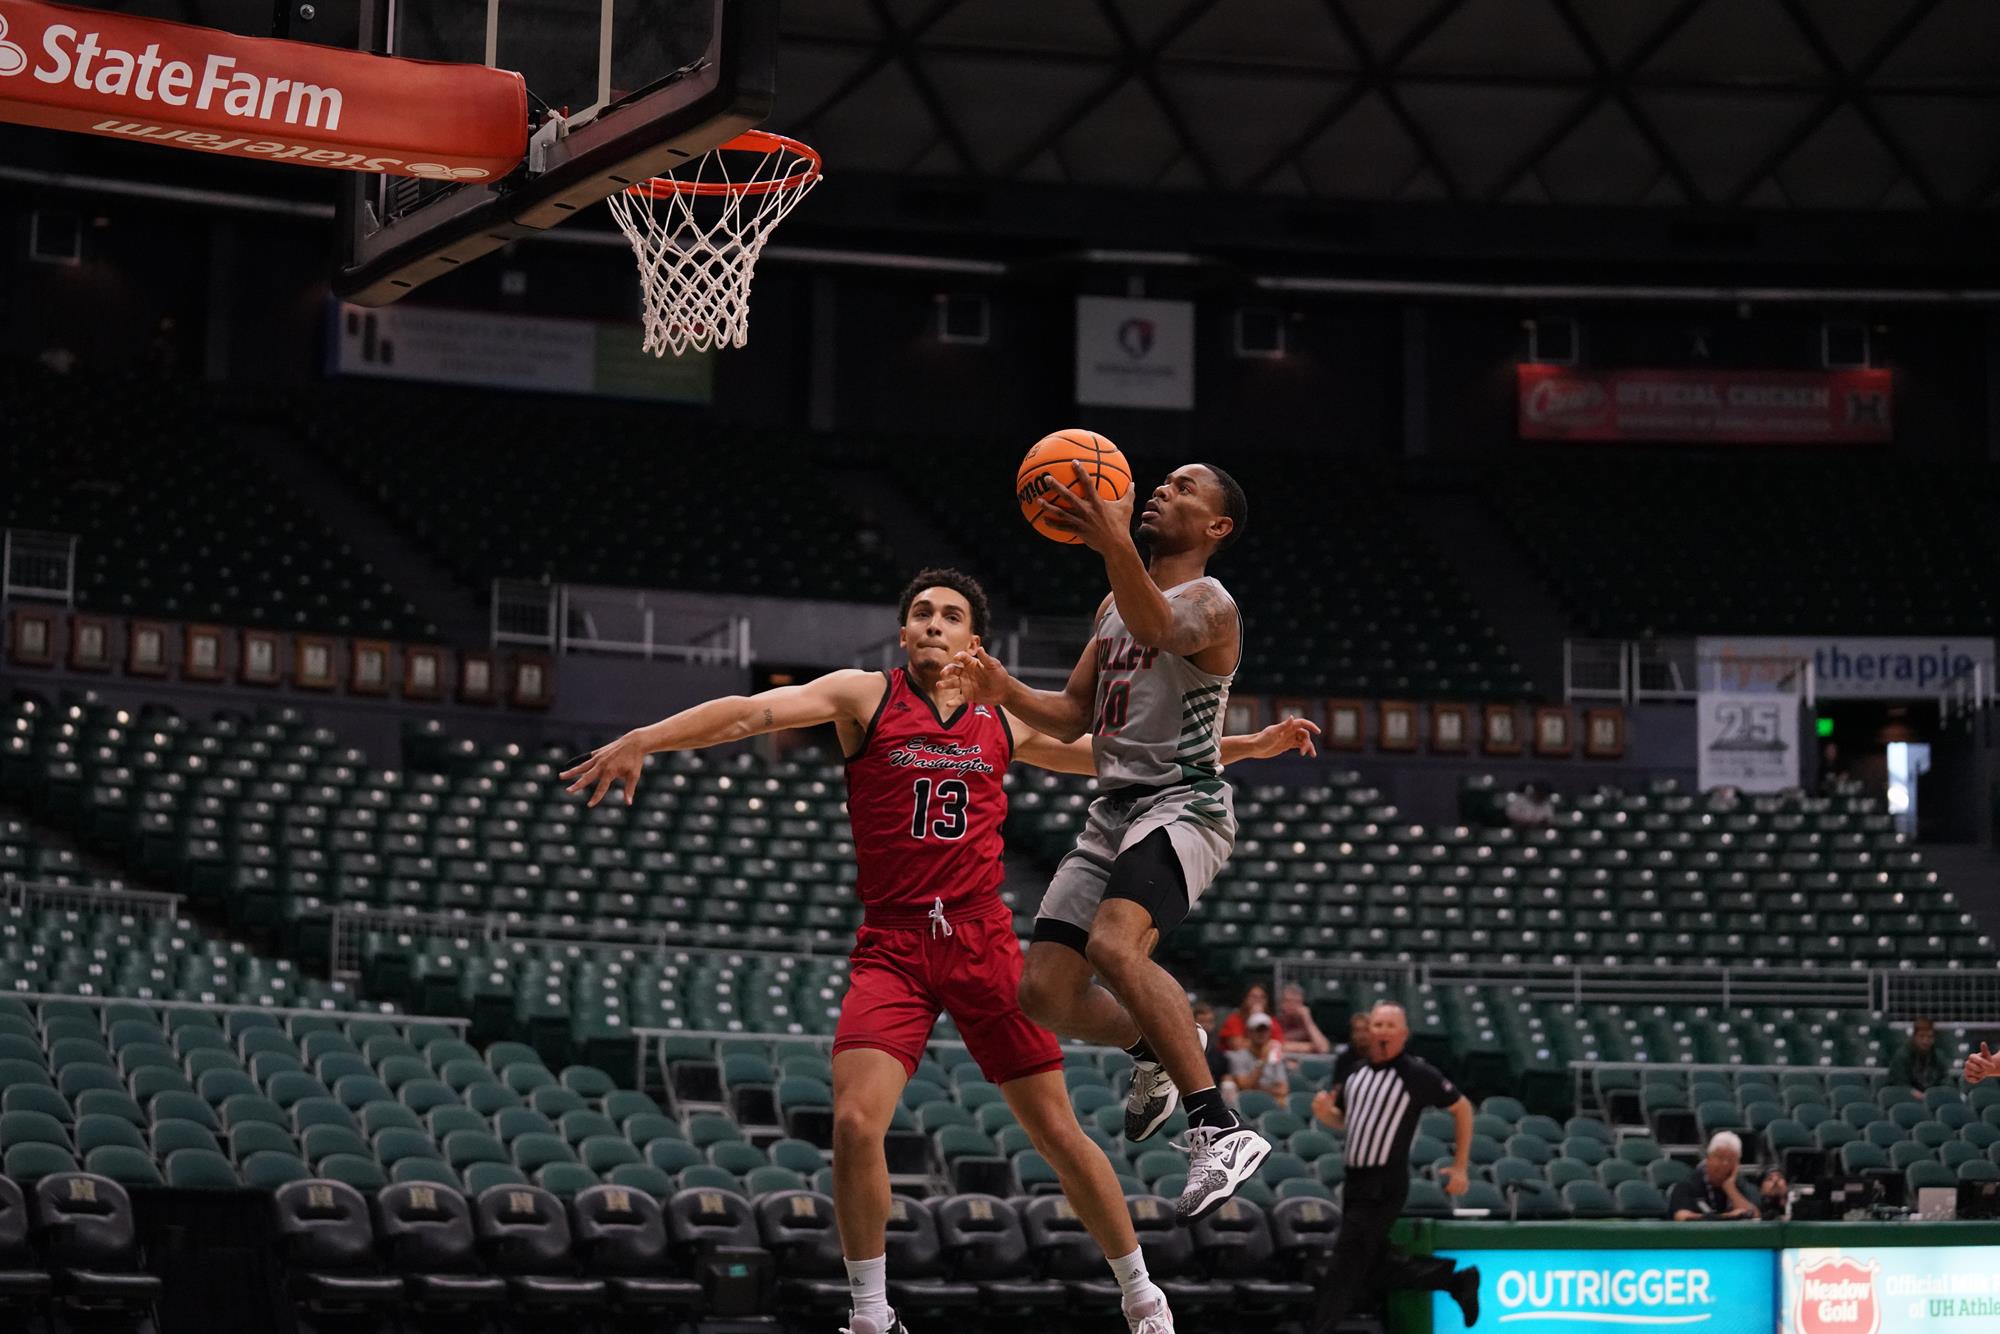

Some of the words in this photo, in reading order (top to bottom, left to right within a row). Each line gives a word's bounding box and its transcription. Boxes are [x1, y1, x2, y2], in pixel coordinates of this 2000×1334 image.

[1814, 644, 1975, 688] therapie
[905, 736, 982, 757] Eastern
[887, 750, 993, 777] Washington
[911, 777, 969, 840] 13
[1496, 1269, 1711, 1308] OUTRIGGER
[1804, 1279, 1871, 1301] Meadow
[1885, 1272, 1949, 1296] Official
[1818, 1300, 1858, 1323] Gold
[1907, 1297, 1926, 1319] of
[1929, 1298, 1954, 1318] UH
